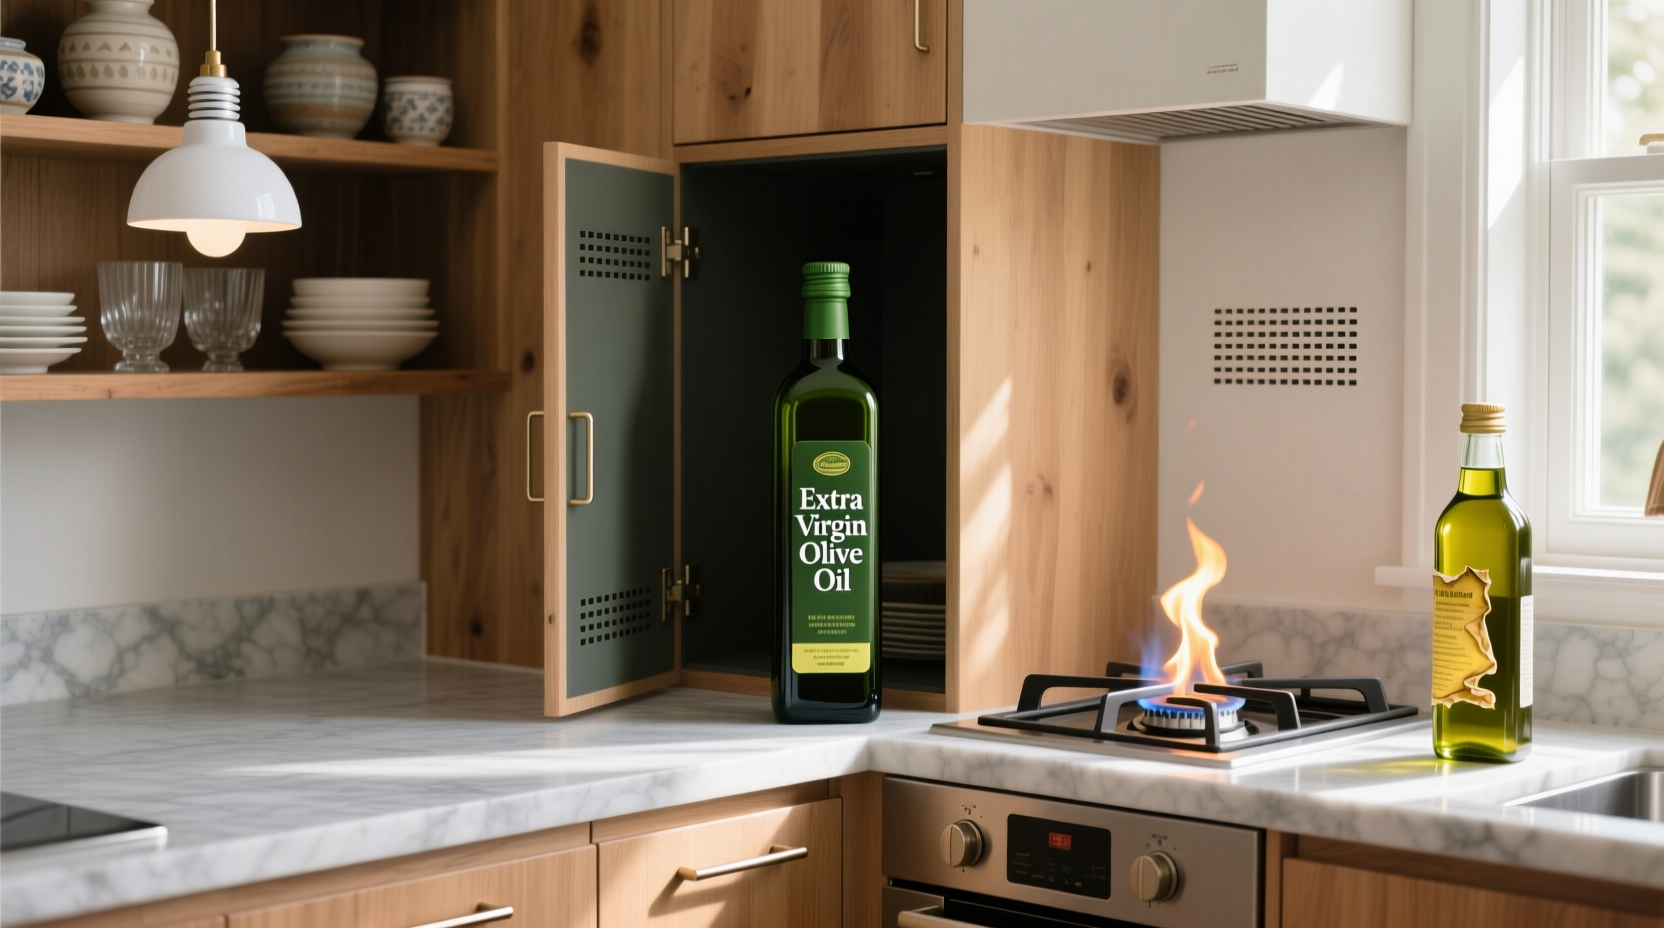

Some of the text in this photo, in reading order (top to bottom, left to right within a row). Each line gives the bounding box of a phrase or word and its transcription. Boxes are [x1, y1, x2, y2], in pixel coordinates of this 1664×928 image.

[799, 487, 864, 510] Extra
[794, 513, 867, 543] Virgin
[799, 540, 863, 565] Olive
[814, 567, 851, 592] Oil
